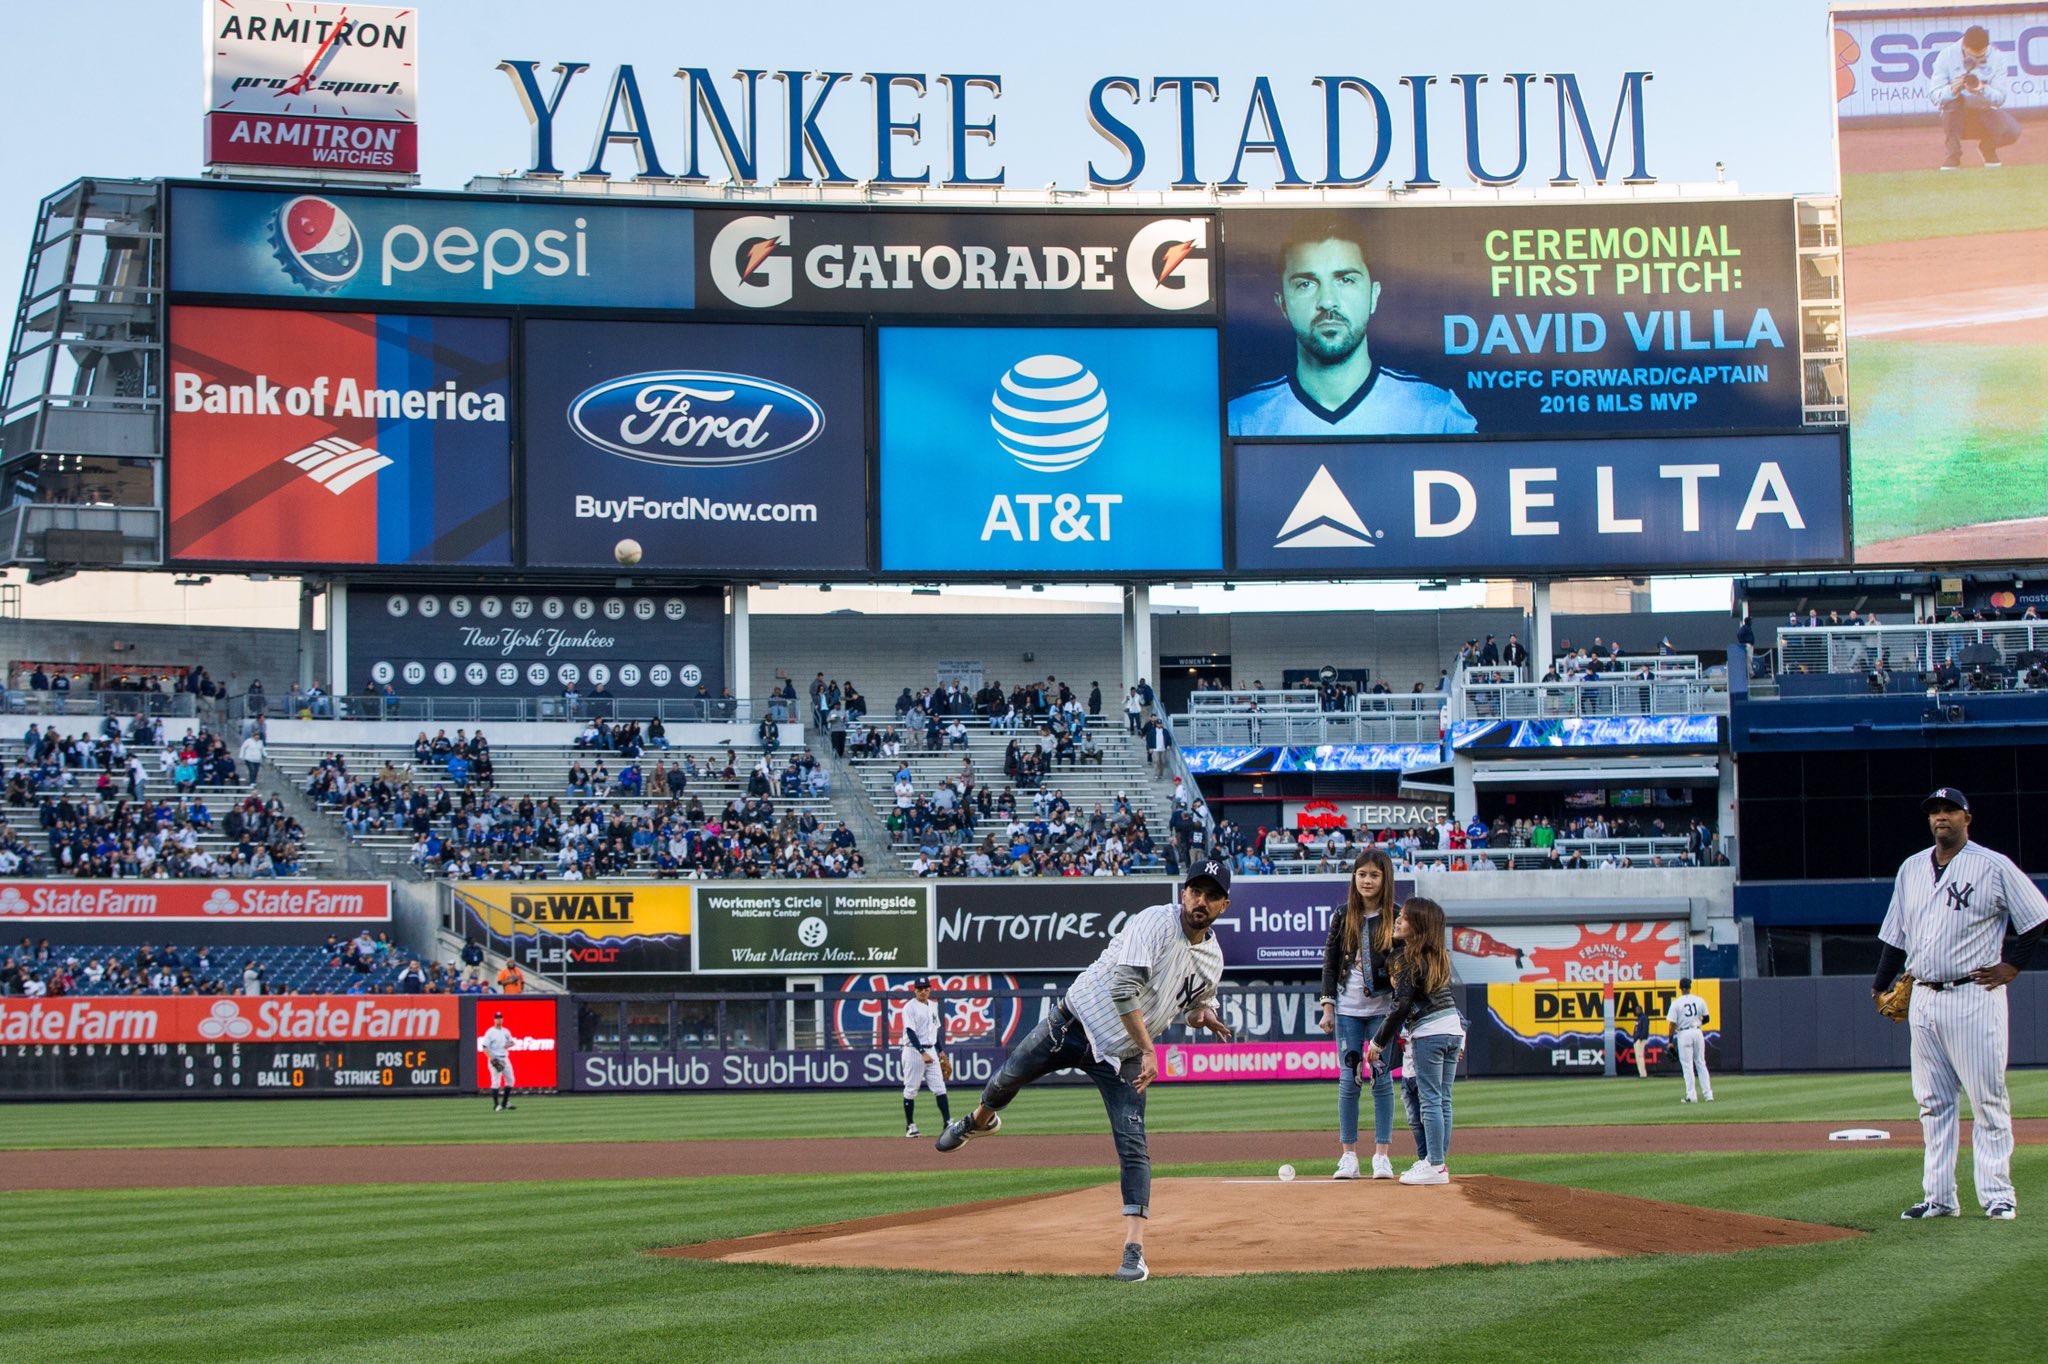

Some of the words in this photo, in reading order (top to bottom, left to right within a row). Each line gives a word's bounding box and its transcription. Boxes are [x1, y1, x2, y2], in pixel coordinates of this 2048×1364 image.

[220, 15, 406, 49] ARMITRON
[231, 77, 287, 92] pro
[318, 81, 400, 96] sport
[1871, 86, 1928, 102] PHARM
[229, 120, 398, 150] ARMITRON
[495, 60, 1005, 187] YANKEE
[1086, 71, 1658, 189] STADIUM
[312, 148, 394, 165] WATCHES
[382, 218, 588, 290] pepsi
[1485, 224, 1741, 262] CEREMONIAL
[710, 215, 793, 308] G
[805, 244, 1114, 290] GATORADE
[1126, 218, 1210, 310] G
[1491, 263, 1601, 297] FIRST
[1616, 261, 1742, 295] PITCH:
[1443, 313, 1607, 355] DAVID
[1623, 308, 1784, 351] VILLA
[1467, 369, 1543, 389] NYCFC
[1551, 364, 1768, 388] FORWARD/CAPTAIN
[173, 372, 281, 415] Bank
[281, 376, 329, 417] of
[329, 378, 506, 422] America
[1540, 394, 1590, 413] 2016
[1598, 393, 1643, 412] MLS
[1650, 392, 1698, 411] MVP
[620, 384, 774, 448] Ford
[575, 495, 818, 523] BuyFordNow.com
[1414, 461, 1806, 538] DELTA
[980, 493, 1123, 542] AT&T
[460, 626, 500, 647] New
[501, 627, 543, 656] York
[545, 628, 615, 656] Yankees
[1352, 805, 1447, 824] TERRACE
[708, 897, 781, 909] Workmen's
[784, 896, 822, 909] Circle
[732, 909, 771, 917] MultiCare
[773, 909, 801, 917] Center
[835, 896, 916, 909] Morningside
[938, 907, 1136, 944] NITTOTIRE.C
[731, 948, 766, 962] What
[769, 947, 819, 962] Matters
[1260, 949, 1300, 957] Download
[1302, 949, 1315, 957] the
[1578, 944, 1627, 959] FRANK'S
[1564, 960, 1643, 983] RedHot
[1684, 1003, 1698, 1017] 31
[18, 1044, 26, 1057] 2
[35, 1044, 43, 1056] 3
[52, 1044, 60, 1056] 4
[69, 1044, 78, 1056] 5
[86, 1044, 95, 1056] 6
[105, 1044, 112, 1056] 7
[121, 1044, 129, 1056] 8
[138, 1044, 147, 1056] 9
[152, 1043, 167, 1055] 10
[206, 1043, 216, 1055] H
[232, 1043, 240, 1055] E
[272, 1053, 291, 1068] AT
[292, 1053, 316, 1068] BAT
[376, 1052, 403, 1067] POS
[185, 1056, 194, 1069] 0
[213, 1056, 222, 1068] 0
[232, 1055, 240, 1068] 0
[585, 1052, 705, 1087] StubHub
[723, 1052, 848, 1085] StubHub
[1192, 1052, 1282, 1073] DUNKIN'
[1285, 1052, 1340, 1071] DON
[185, 1073, 194, 1086] 0
[213, 1073, 222, 1086] 0
[232, 1072, 240, 1086] 0
[257, 1072, 291, 1086] BALL
[292, 1069, 304, 1087] 0
[334, 1071, 381, 1085] STRIKE
[382, 1069, 393, 1086] 0
[411, 1070, 438, 1085] OUT
[440, 1068, 451, 1085] 0
